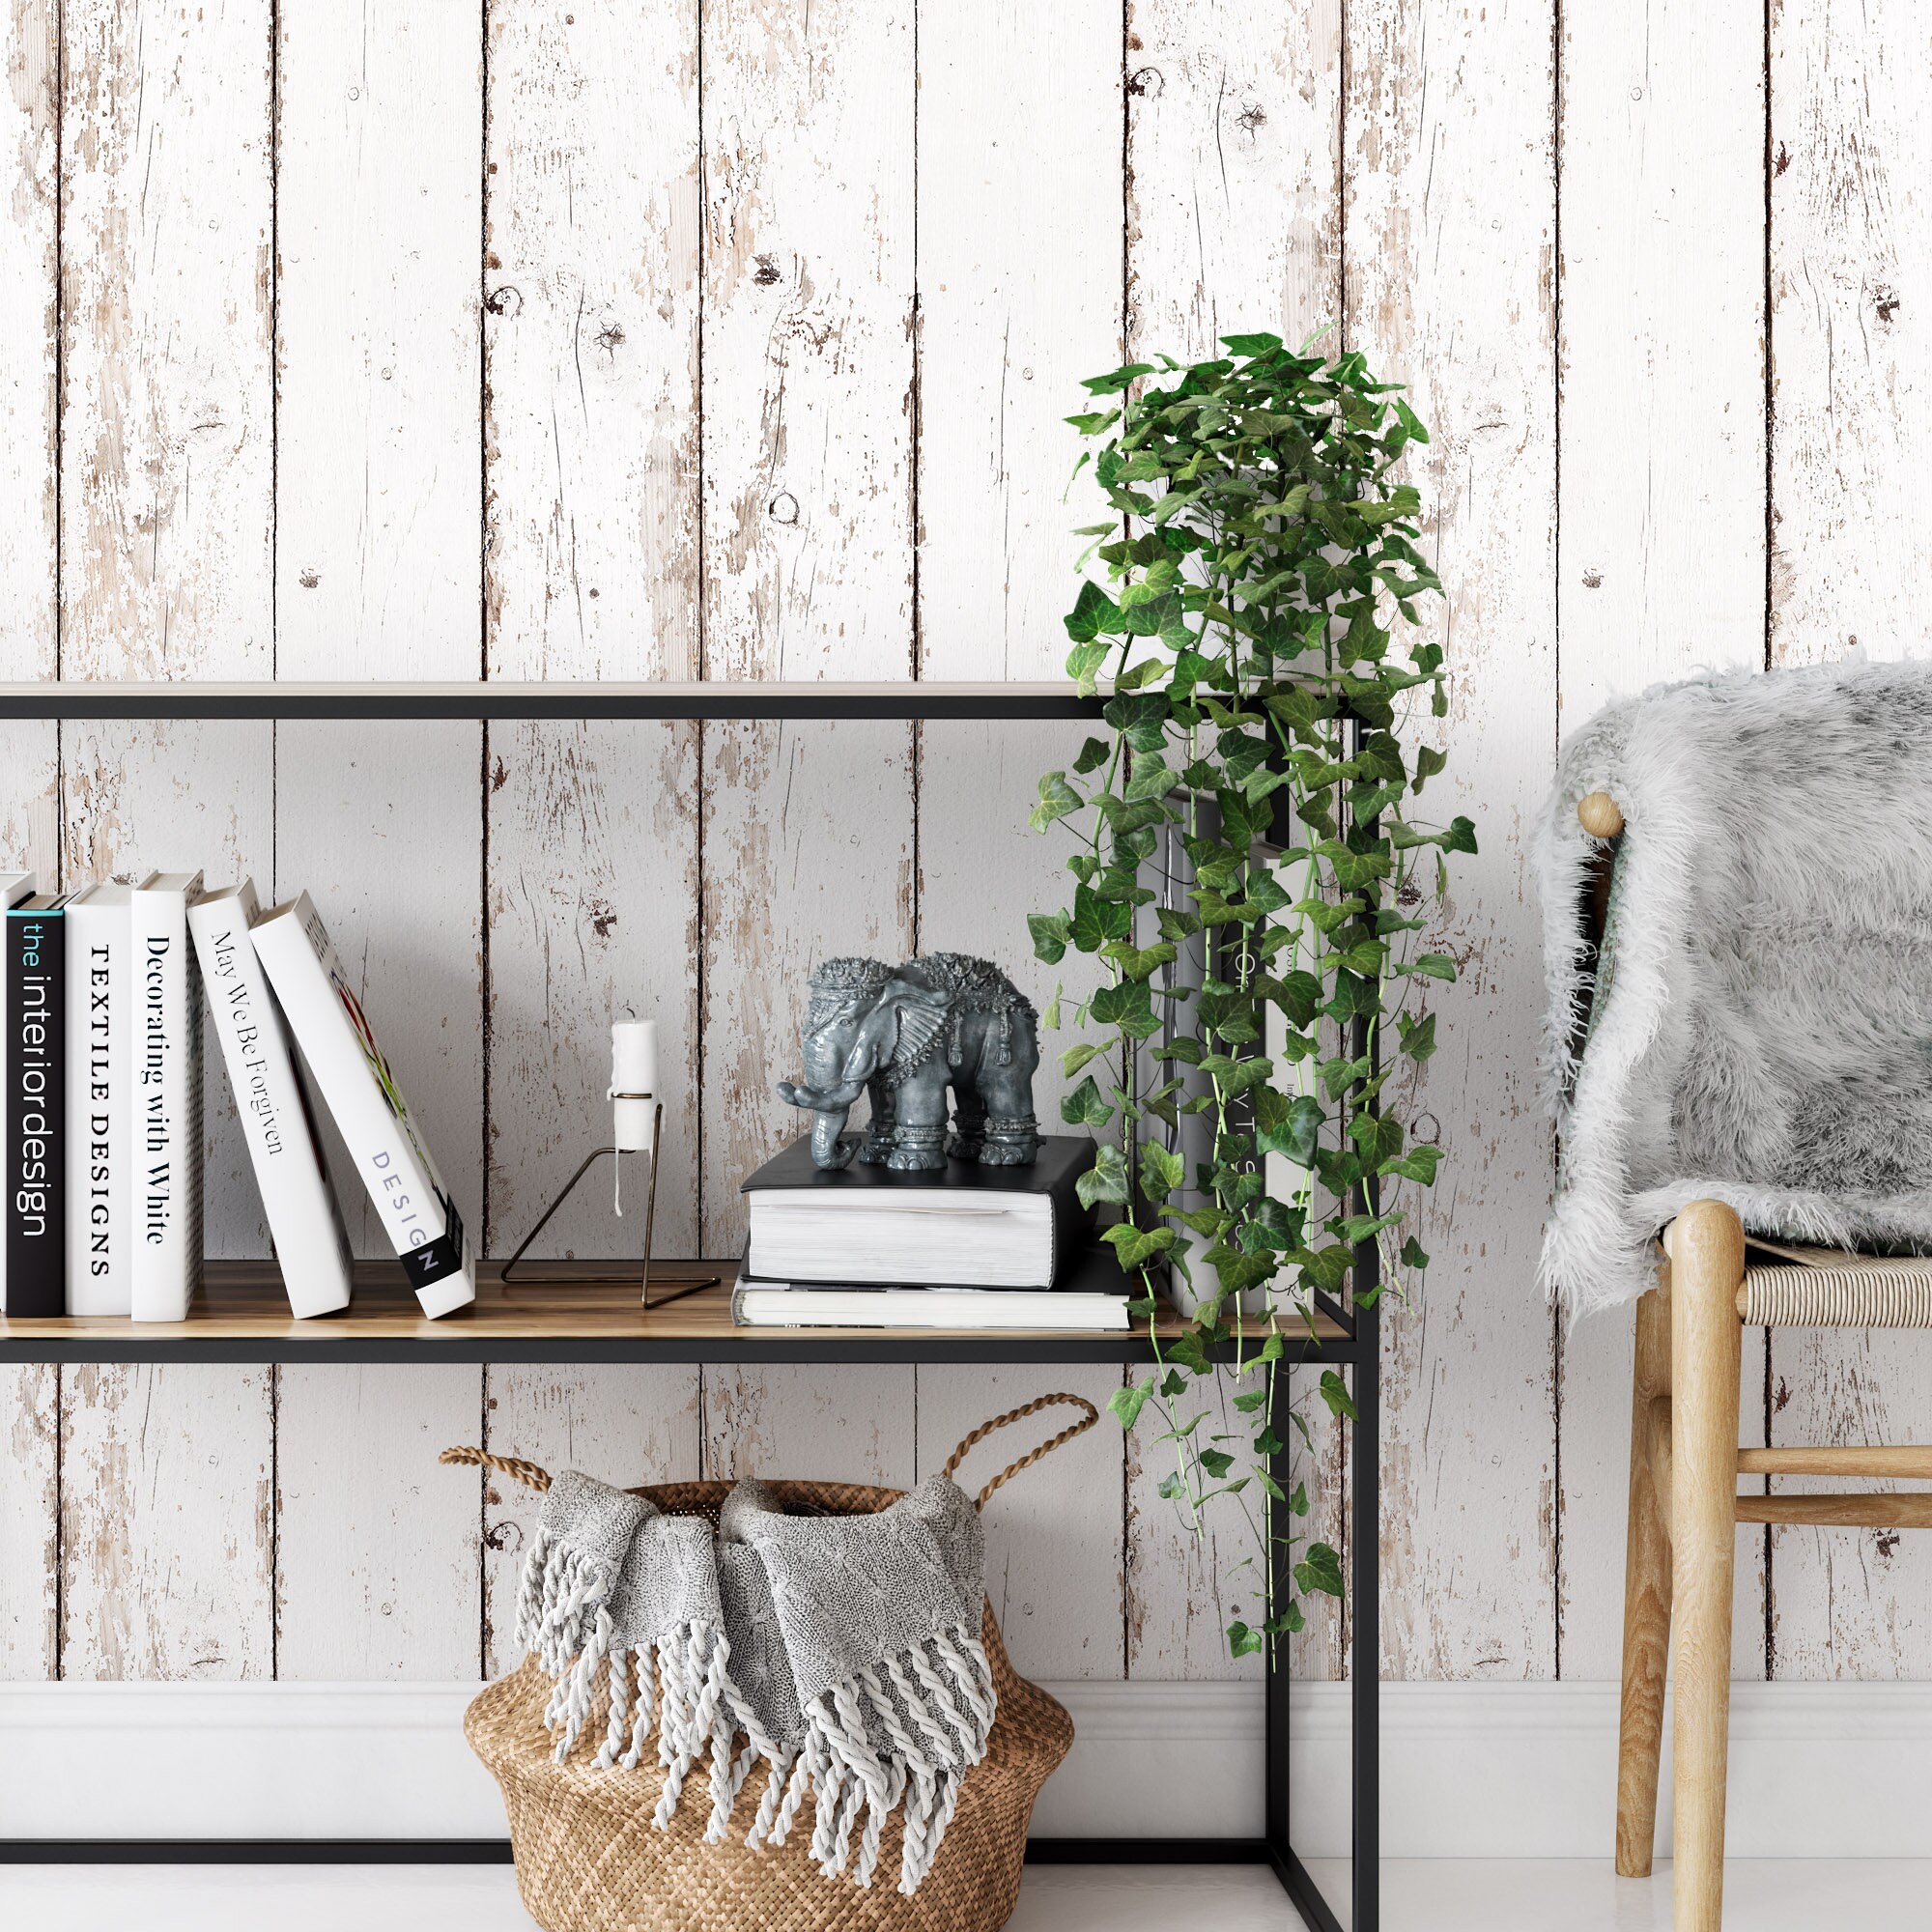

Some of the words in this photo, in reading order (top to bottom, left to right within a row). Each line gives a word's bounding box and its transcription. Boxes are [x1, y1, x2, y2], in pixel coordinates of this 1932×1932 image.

[22, 923, 44, 967] the
[212, 930, 236, 979] May
[22, 976, 52, 1108] interior
[91, 944, 110, 1101] TEXTILE
[140, 936, 171, 1085] Decorating
[227, 982, 250, 1022] We
[237, 1026, 258, 1055] Be
[147, 1094, 171, 1152] with
[245, 1059, 283, 1155] Forgiven
[15, 1113, 54, 1236] design
[90, 1113, 110, 1277] DESIGNS
[146, 1161, 171, 1245] White
[372, 1151, 440, 1272] DESIGN
